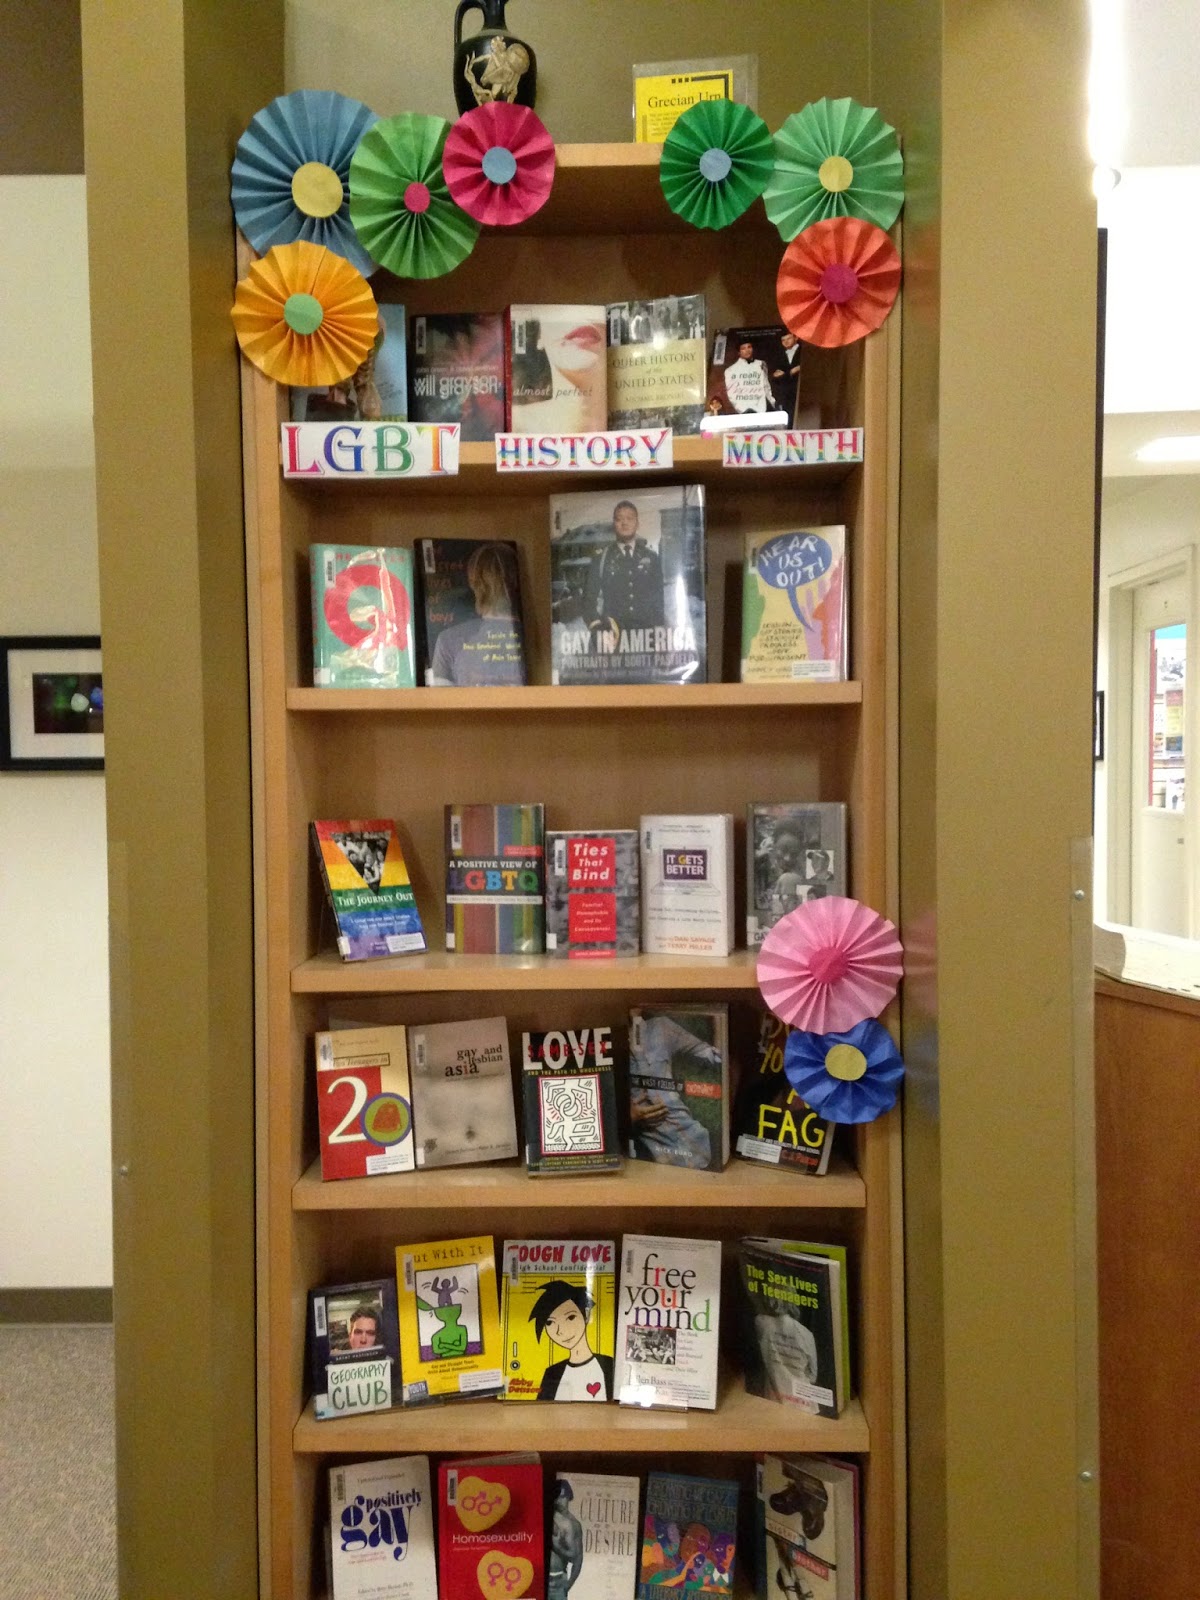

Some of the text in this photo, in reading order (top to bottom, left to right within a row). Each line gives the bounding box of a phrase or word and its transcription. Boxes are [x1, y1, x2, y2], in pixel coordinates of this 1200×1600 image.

[648, 94, 694, 108] Grecian
[612, 352, 697, 369] QUEER HISTORY
[513, 385, 551, 397] almost
[615, 374, 695, 389] UNITED STATES
[284, 425, 458, 476] LGBT
[498, 429, 669, 468] HISTORY
[725, 430, 861, 466] MONTH
[760, 535, 818, 566] HEAR
[779, 552, 804, 569] US
[561, 626, 697, 654] GAY IN AMERICA
[573, 842, 608, 857] Ties
[666, 854, 704, 865] IT GETS
[449, 860, 456, 868] A
[457, 860, 498, 868] POSITIVE
[579, 858, 603, 867] That
[666, 865, 704, 875] BETTER
[449, 870, 539, 892] LGBTQ
[572, 867, 610, 880] Bind
[456, 1044, 503, 1061] gay and
[468, 1053, 503, 1064] lesbian
[521, 1026, 614, 1071] LOVE
[444, 1061, 479, 1077] asia
[758, 1104, 825, 1148] FAG
[414, 1245, 484, 1263] ut With It
[571, 1244, 611, 1263] LOVE
[519, 1264, 530, 1272] igh
[642, 1253, 697, 1290] free
[746, 1264, 764, 1281] The
[767, 1270, 788, 1287] Sex
[790, 1274, 818, 1294] Lives
[624, 1285, 692, 1316] your
[748, 1281, 819, 1310] of Teenagers
[633, 1298, 712, 1333] mind
[330, 1361, 388, 1385] GEOGRAPHY
[509, 1377, 534, 1387] Abby
[332, 1380, 388, 1410] CLUB
[366, 1488, 422, 1513] positively
[580, 1497, 635, 1524] CULTURE
[341, 1495, 415, 1561] gay
[452, 1532, 534, 1544] Homosexuality
[585, 1529, 635, 1556] DESIRE
